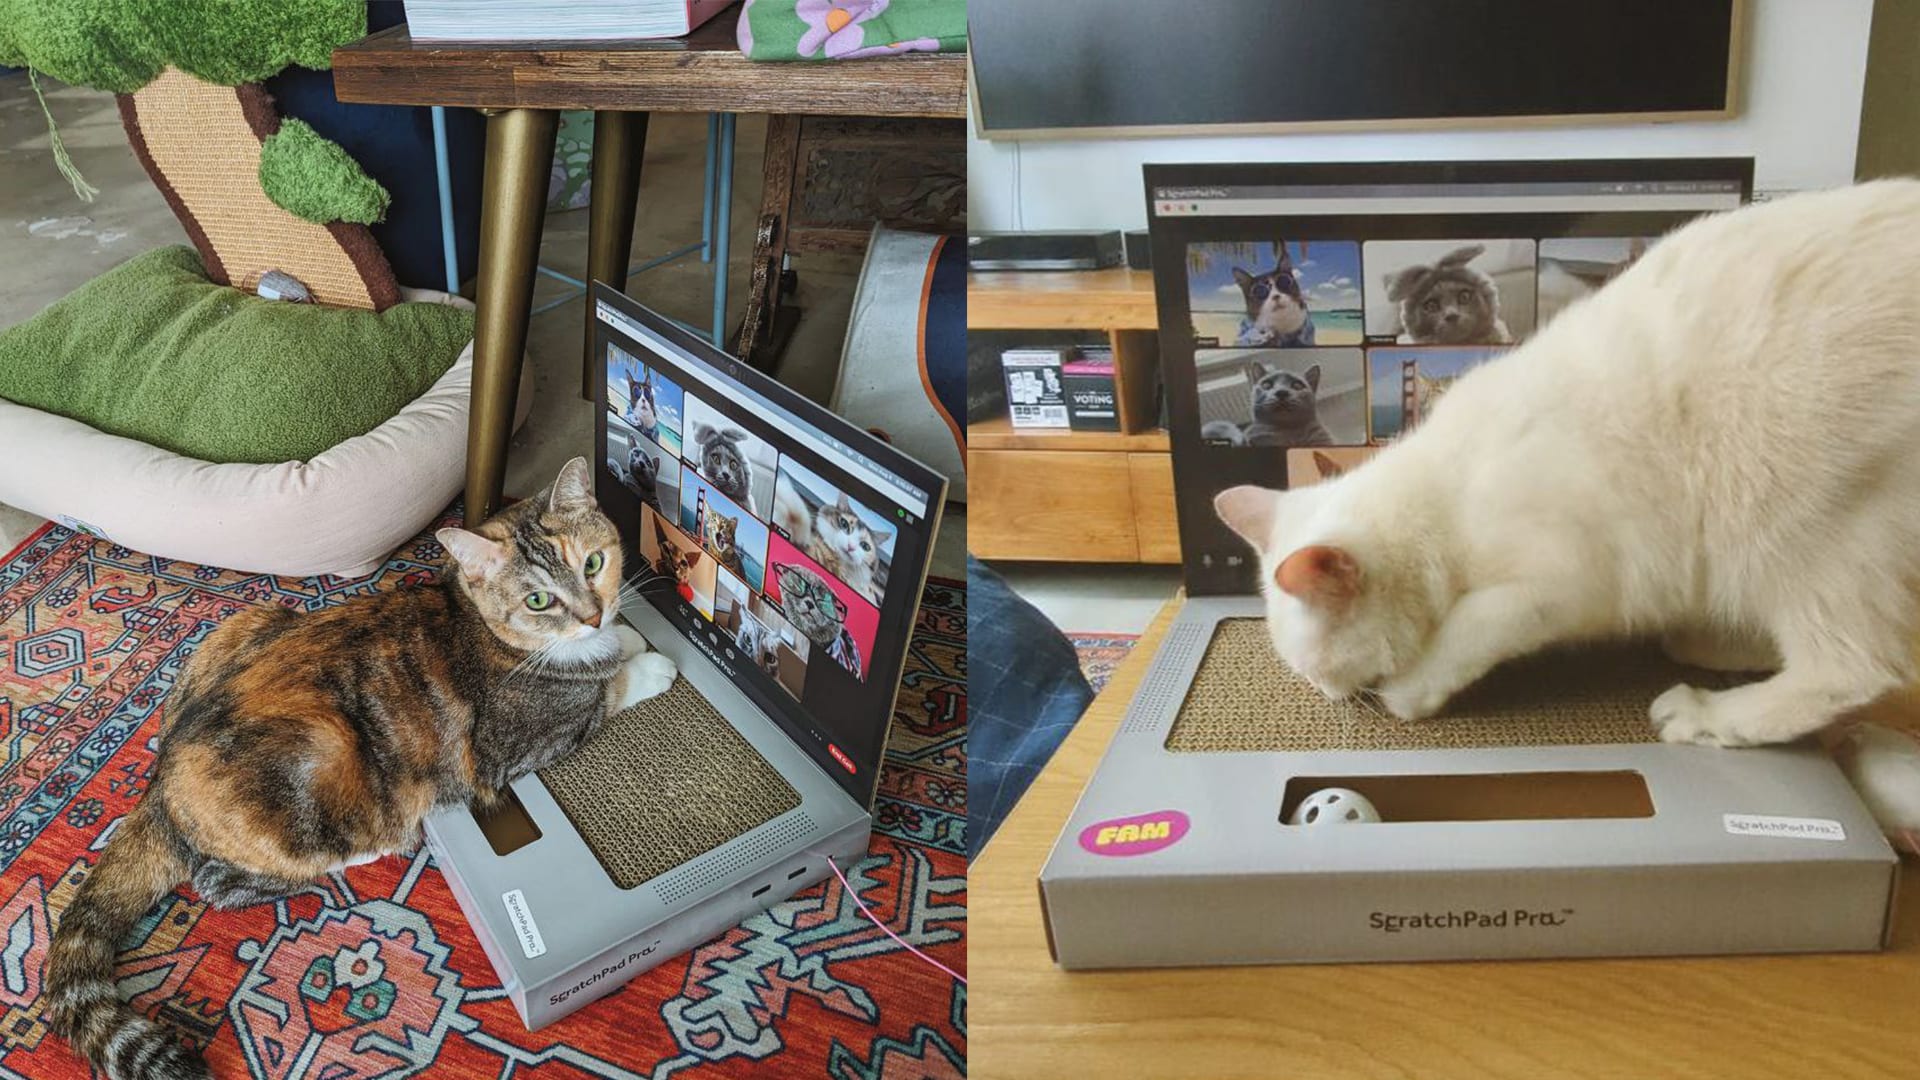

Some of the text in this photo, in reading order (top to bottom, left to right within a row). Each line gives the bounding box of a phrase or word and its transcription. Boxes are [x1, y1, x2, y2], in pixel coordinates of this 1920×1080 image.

[1073, 394, 1113, 404] VOTING
[1095, 821, 1170, 845] FAM
[1369, 909, 1508, 932] ScratchPad
[549, 958, 626, 1005] ScratchPad
